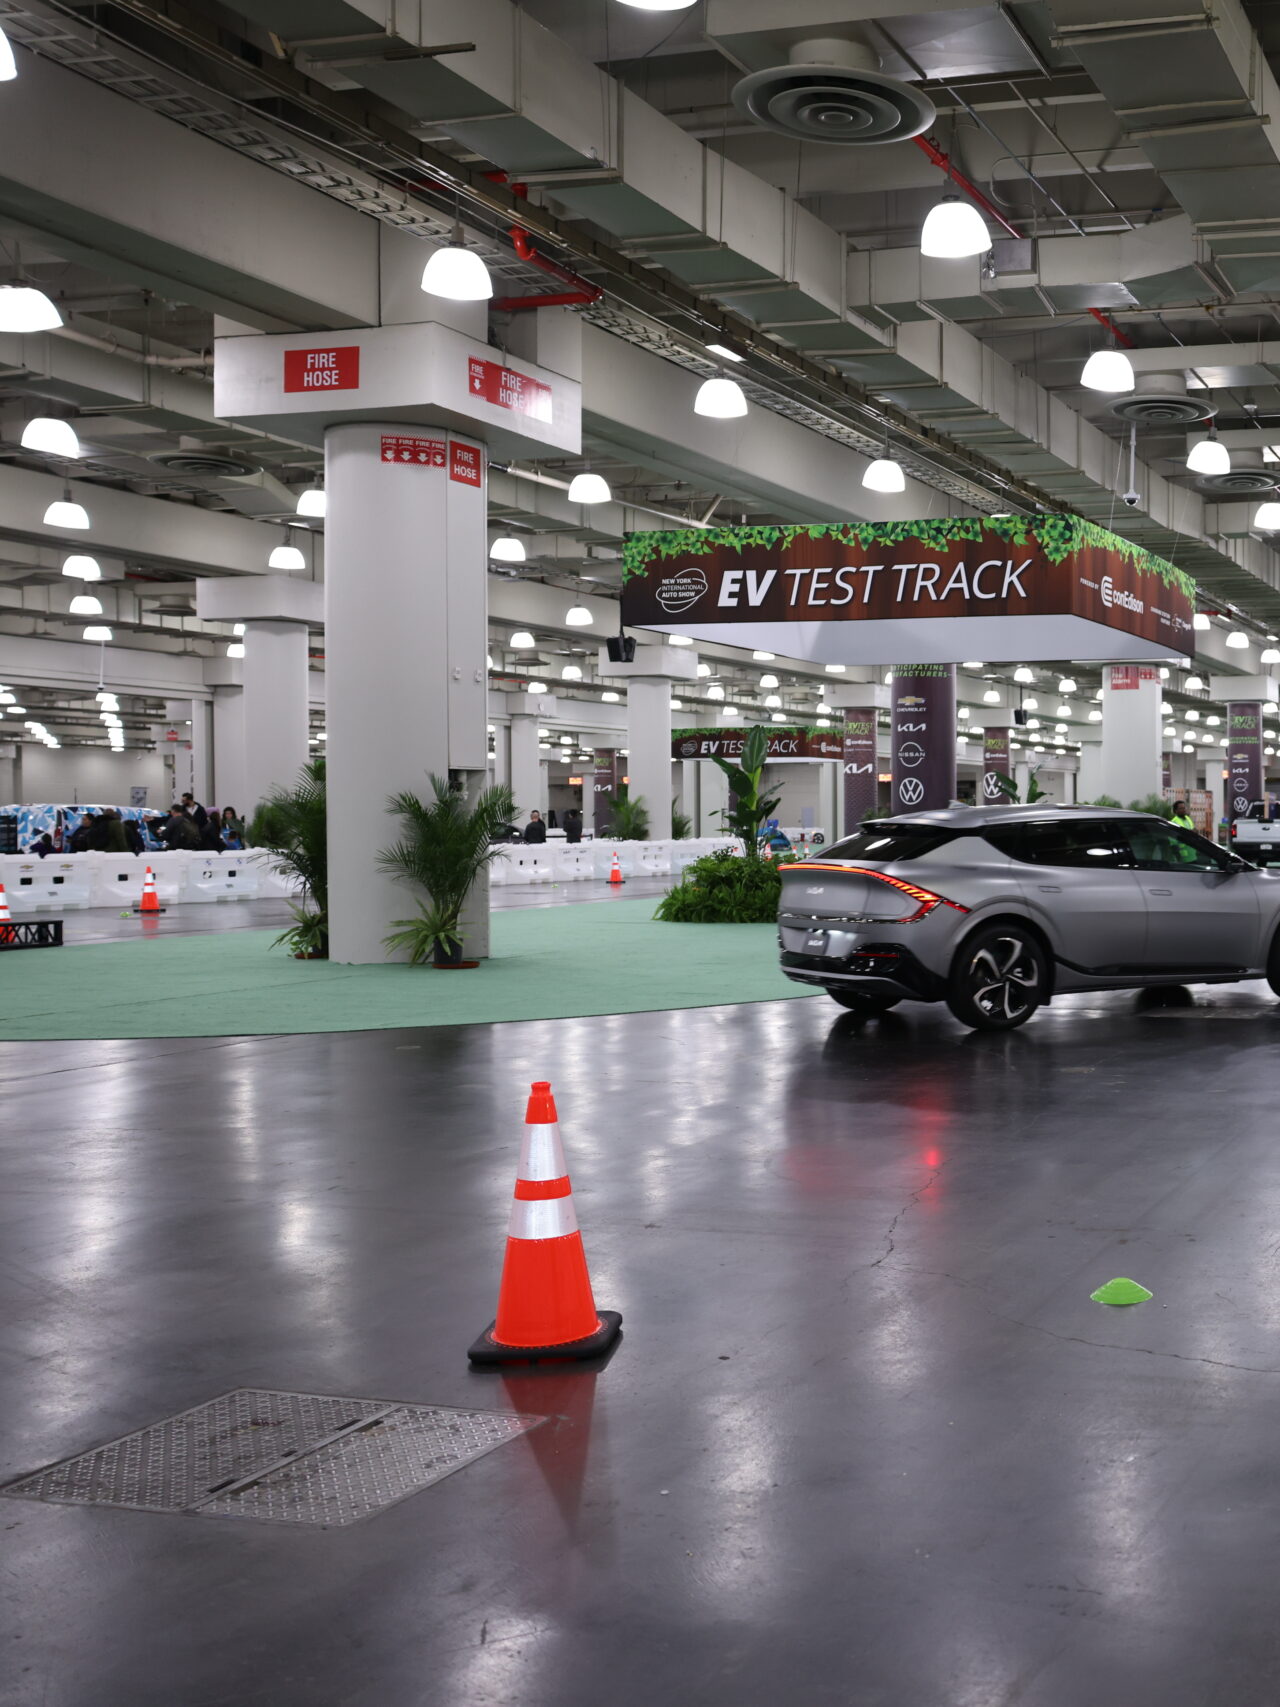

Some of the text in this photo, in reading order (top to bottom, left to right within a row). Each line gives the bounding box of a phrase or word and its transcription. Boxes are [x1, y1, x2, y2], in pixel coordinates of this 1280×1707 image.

[307, 353, 336, 368] FIRE
[471, 364, 484, 373] FIRE
[304, 370, 339, 387] HOSE
[501, 371, 522, 392] FIRE
[500, 387, 524, 408] HOSE
[456, 449, 475, 464] FIRE
[454, 464, 478, 480] HOSE
[717, 558, 1033, 607] EV TEST TRACK
[1113, 589, 1144, 615] conEdison
[897, 723, 927, 732] KIA
[700, 740, 720, 753] EV
[721, 740, 745, 753] TES
[766, 739, 799, 753] RACK
